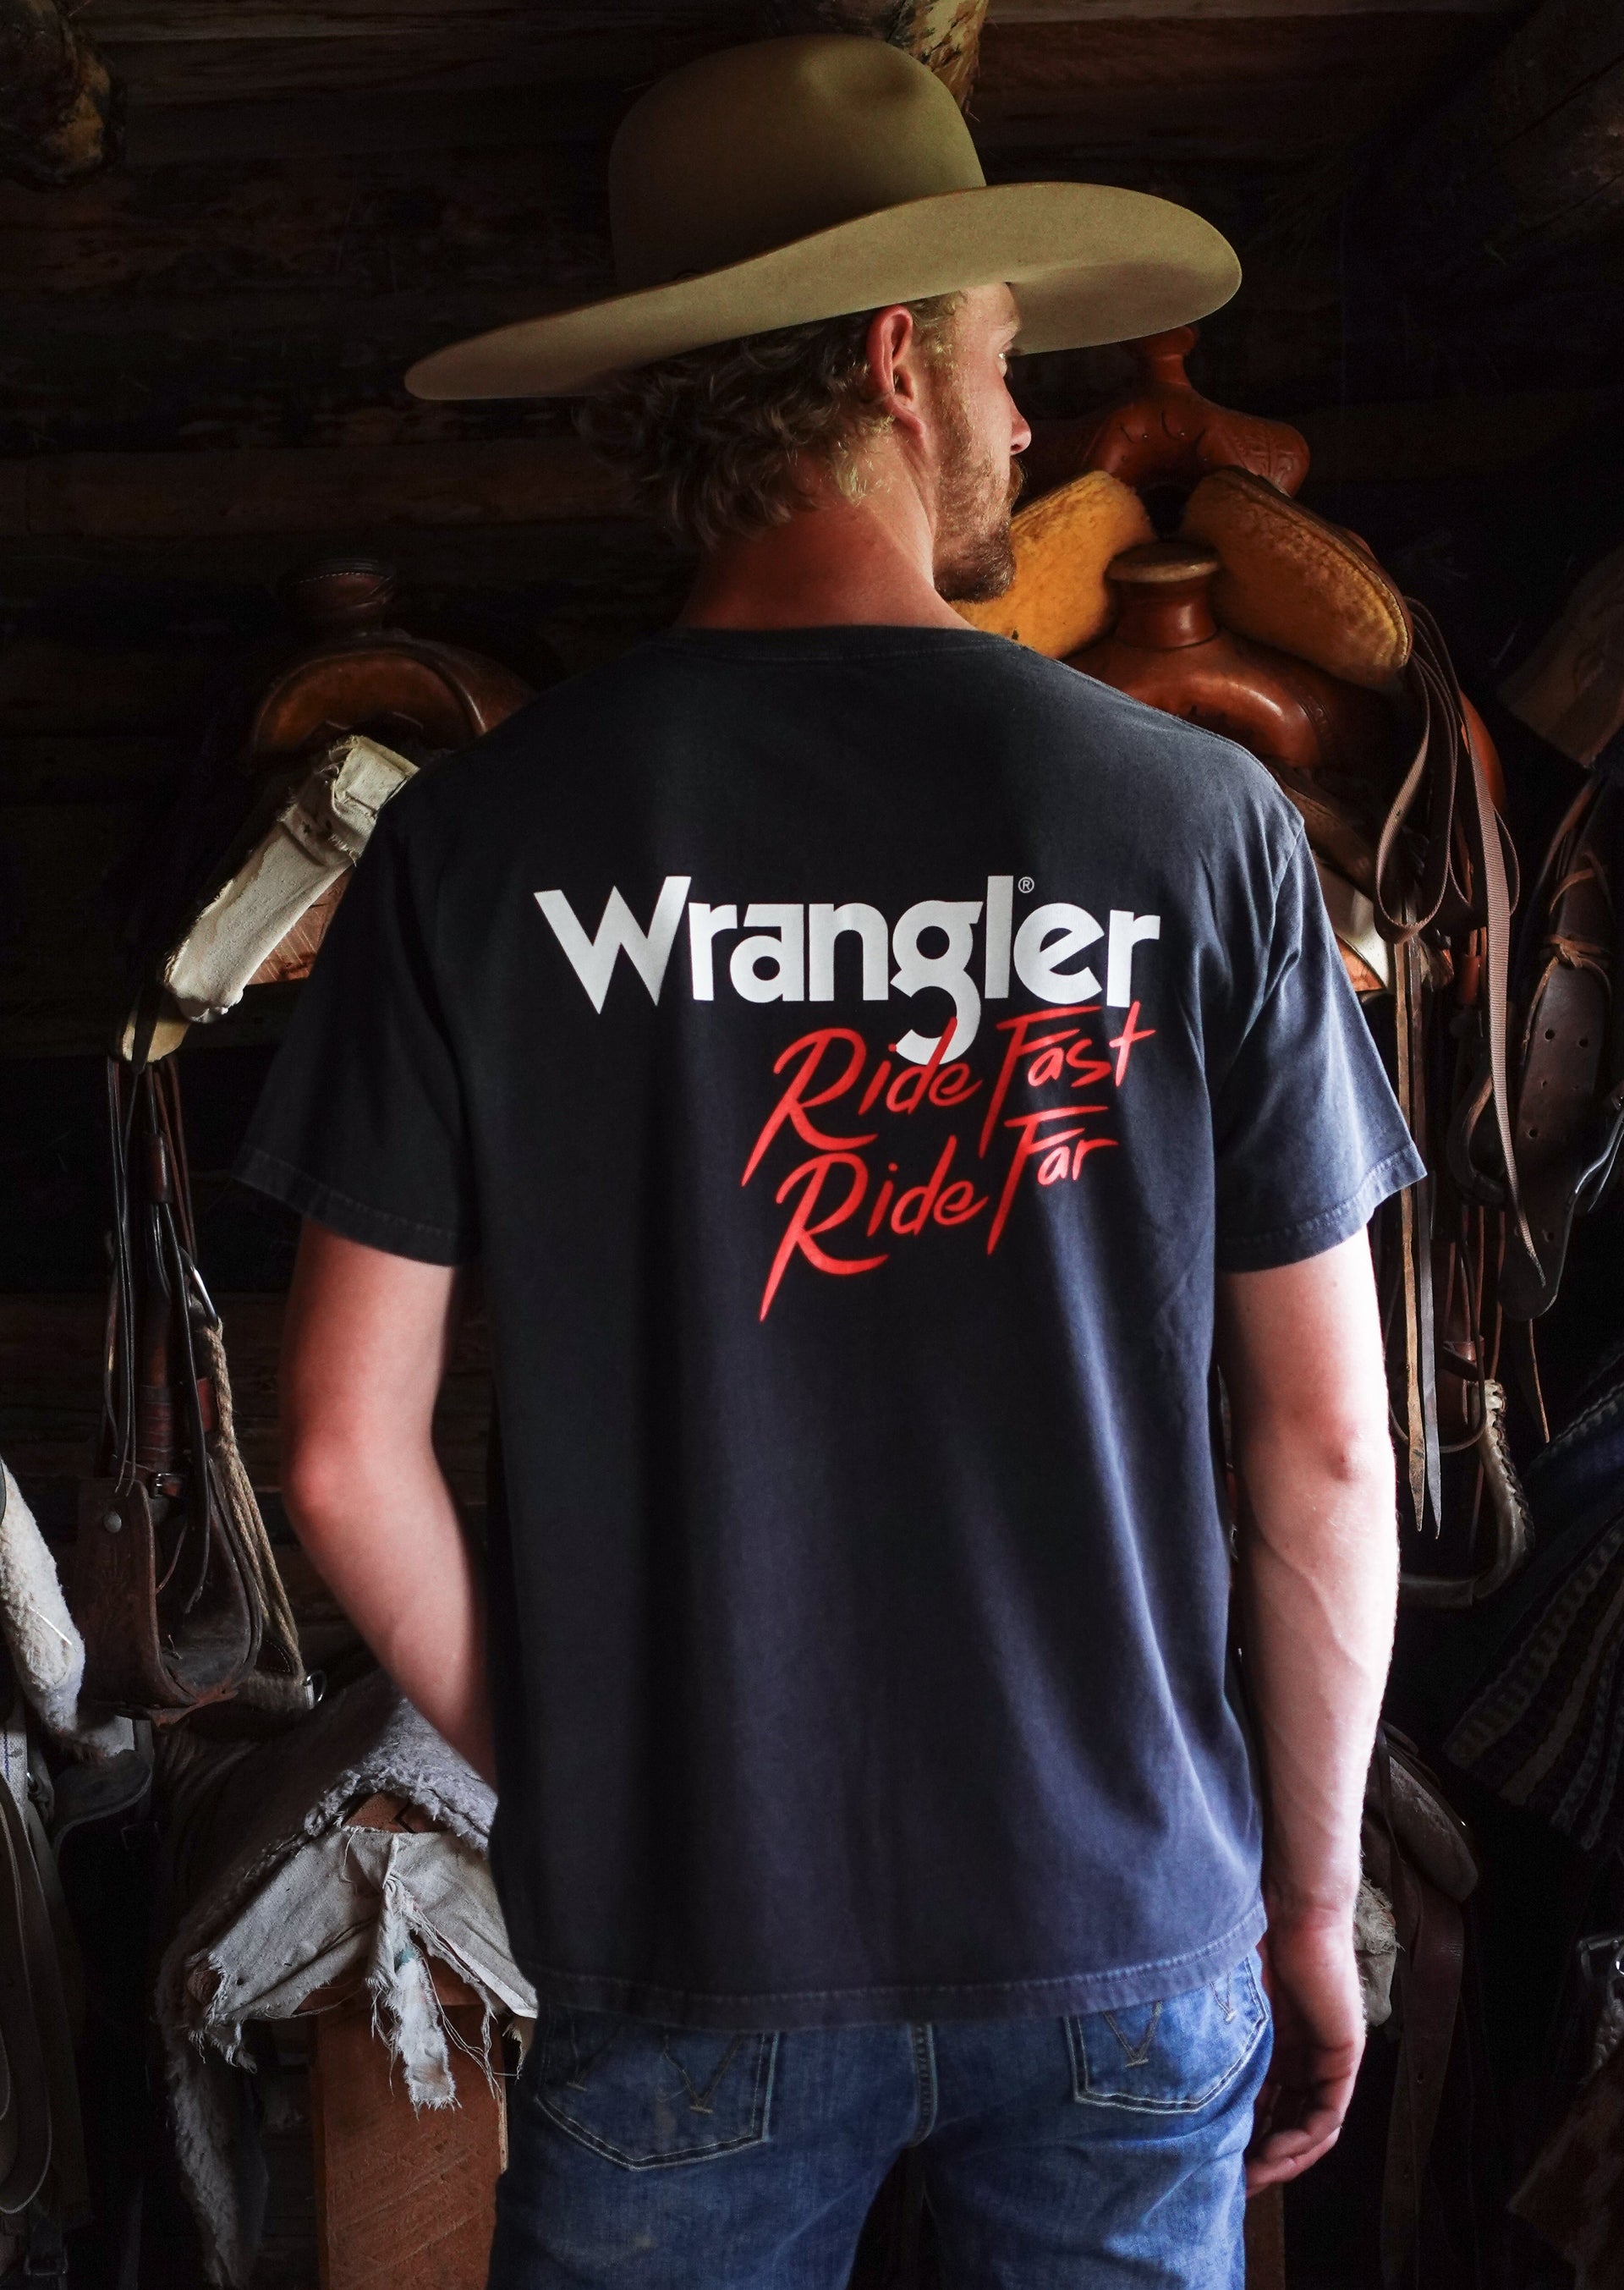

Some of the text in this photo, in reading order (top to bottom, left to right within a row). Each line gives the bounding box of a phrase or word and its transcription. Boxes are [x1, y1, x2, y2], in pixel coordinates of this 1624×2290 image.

[534, 876, 1161, 1065] Wrangler
[741, 1001, 1155, 1186] Ride Fast
[760, 1105, 1118, 1321] Ride Far
